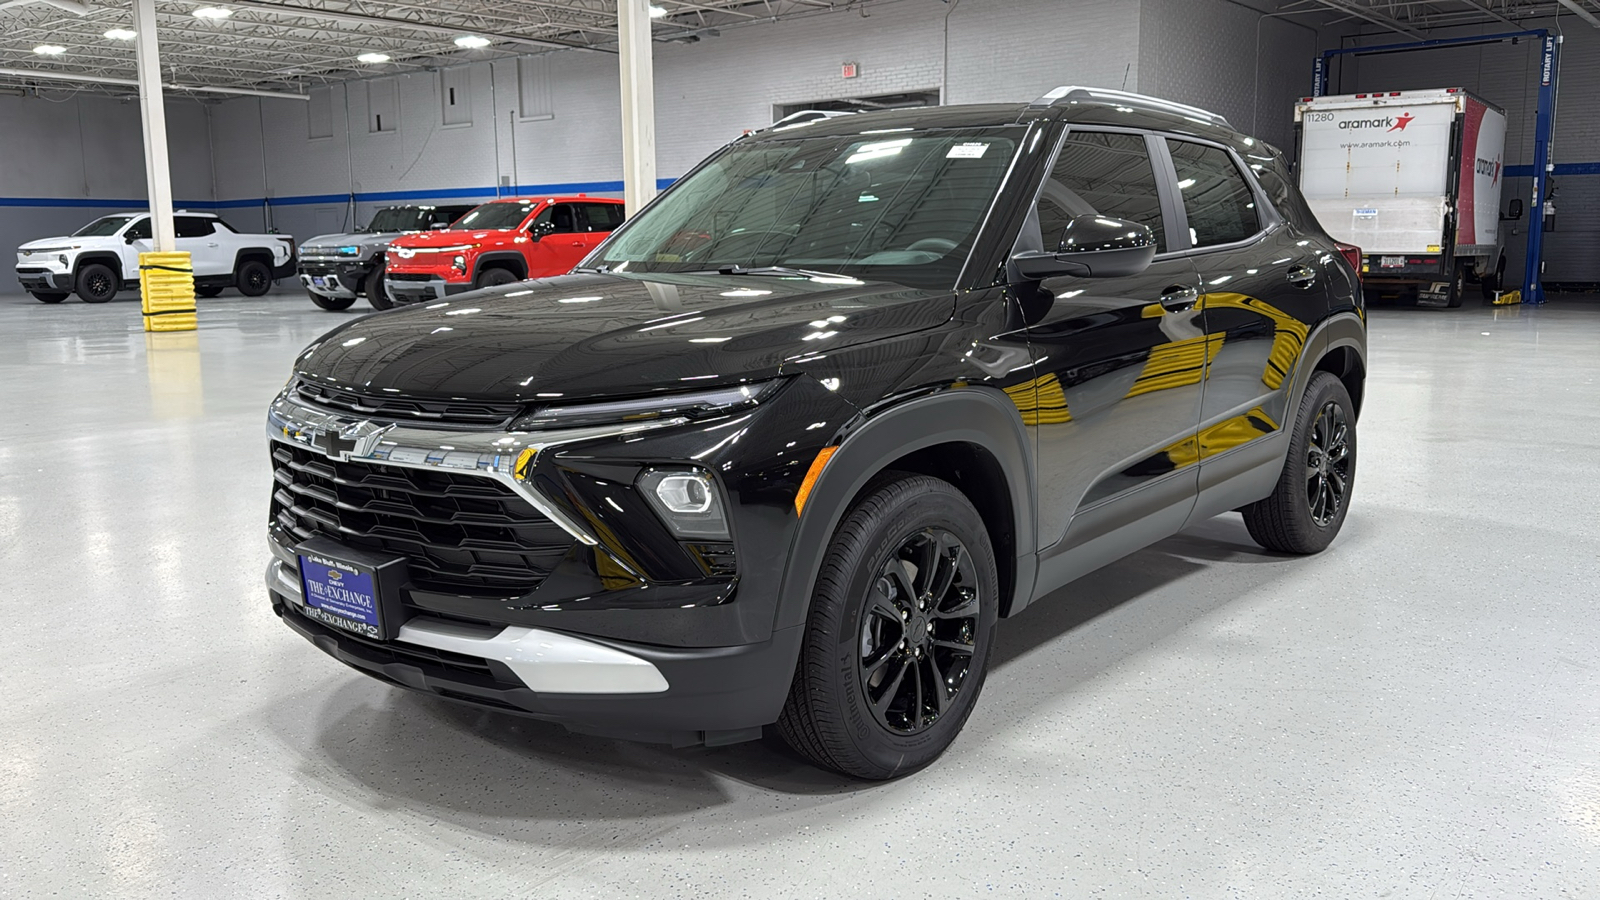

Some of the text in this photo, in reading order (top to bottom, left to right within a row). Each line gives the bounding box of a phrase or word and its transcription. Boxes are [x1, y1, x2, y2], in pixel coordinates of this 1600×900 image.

[1543, 53, 1552, 82] ROTARY
[1307, 113, 1334, 122] 11280
[1338, 116, 1393, 129] aramark
[1340, 140, 1410, 149] www.aramark.com
[311, 555, 322, 563] Lake
[335, 562, 353, 571] Illinois
[308, 579, 372, 608] THE EXCHANGE
[304, 606, 363, 633] THE EXCHANGE
